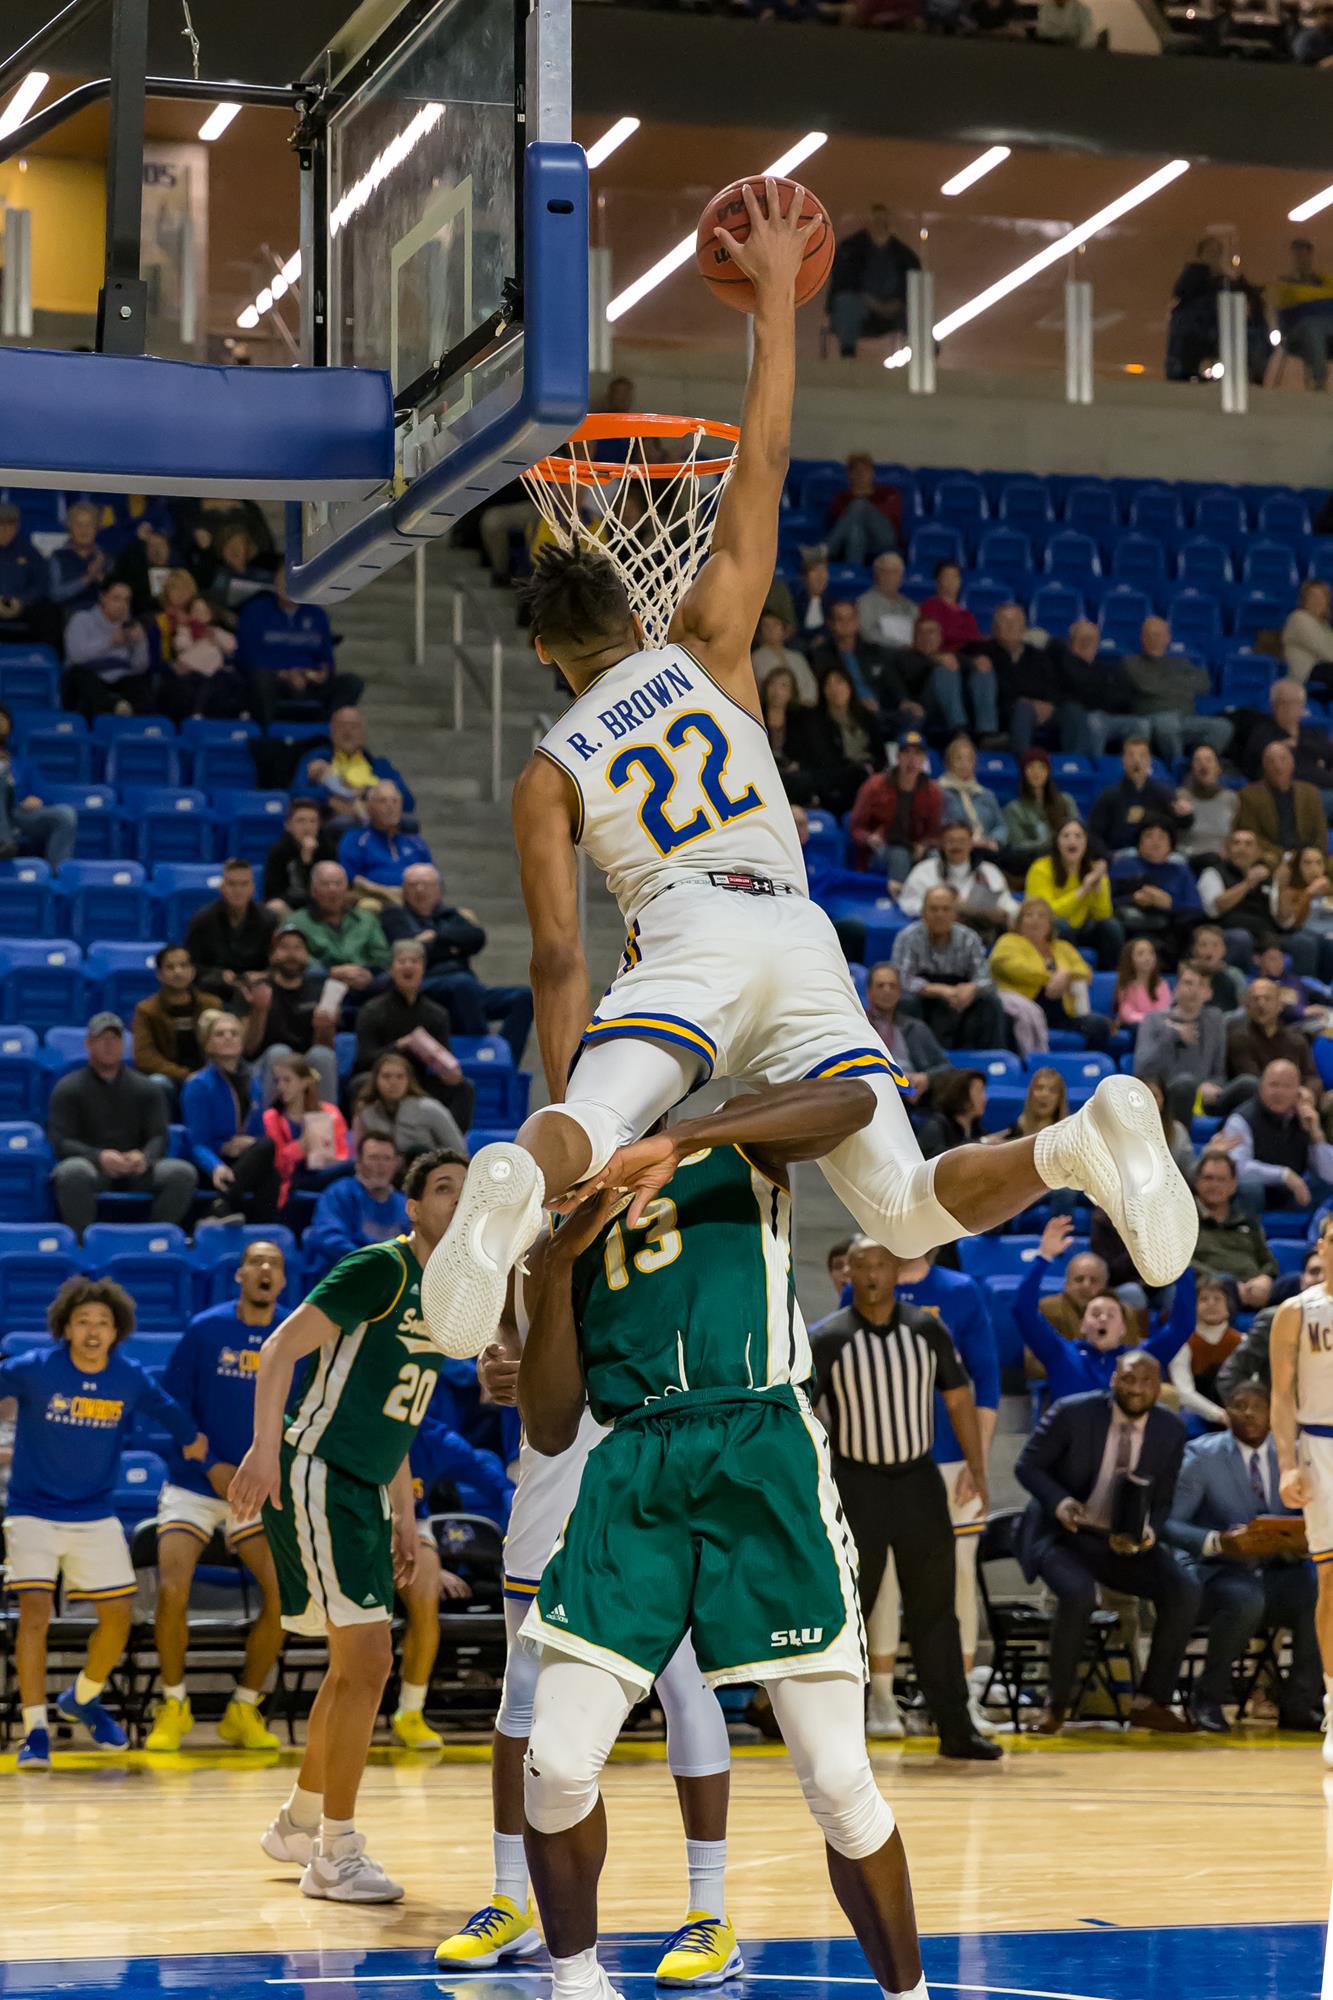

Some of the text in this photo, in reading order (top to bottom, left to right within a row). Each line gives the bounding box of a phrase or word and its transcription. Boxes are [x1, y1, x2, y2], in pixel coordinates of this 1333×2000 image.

[566, 662, 694, 762] R. BROWN
[605, 709, 767, 860] 22
[604, 1196, 683, 1291] 13
[382, 1362, 438, 1427] 20
[770, 1627, 824, 1648] SLU
